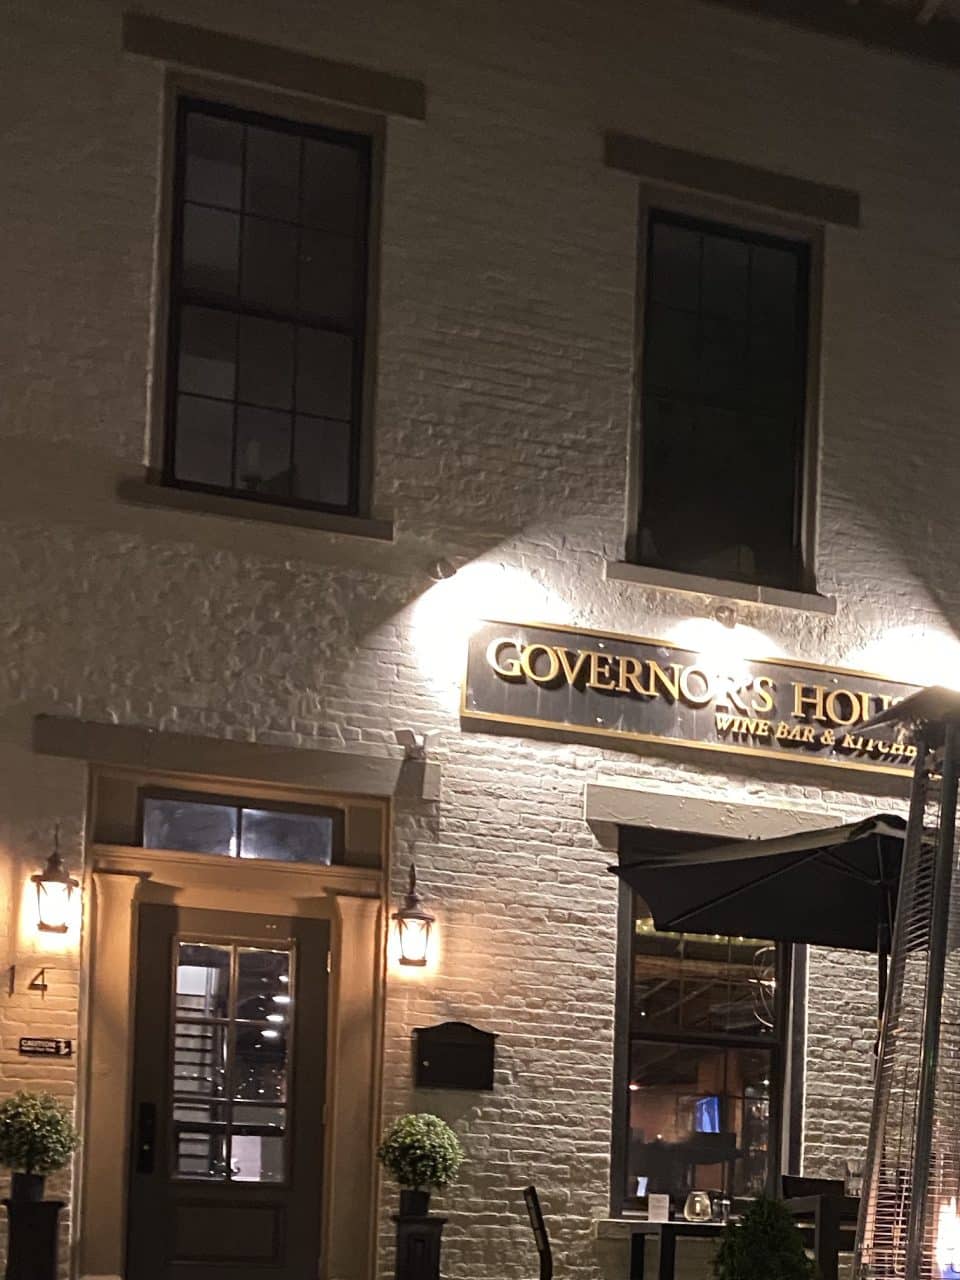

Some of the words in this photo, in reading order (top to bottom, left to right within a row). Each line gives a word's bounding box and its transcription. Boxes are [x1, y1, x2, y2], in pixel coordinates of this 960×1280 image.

[791, 681, 906, 726] HOU
[715, 712, 769, 736] WINE
[776, 721, 815, 742] BAR
[820, 728, 836, 745] &
[842, 733, 919, 757] KITCHE
